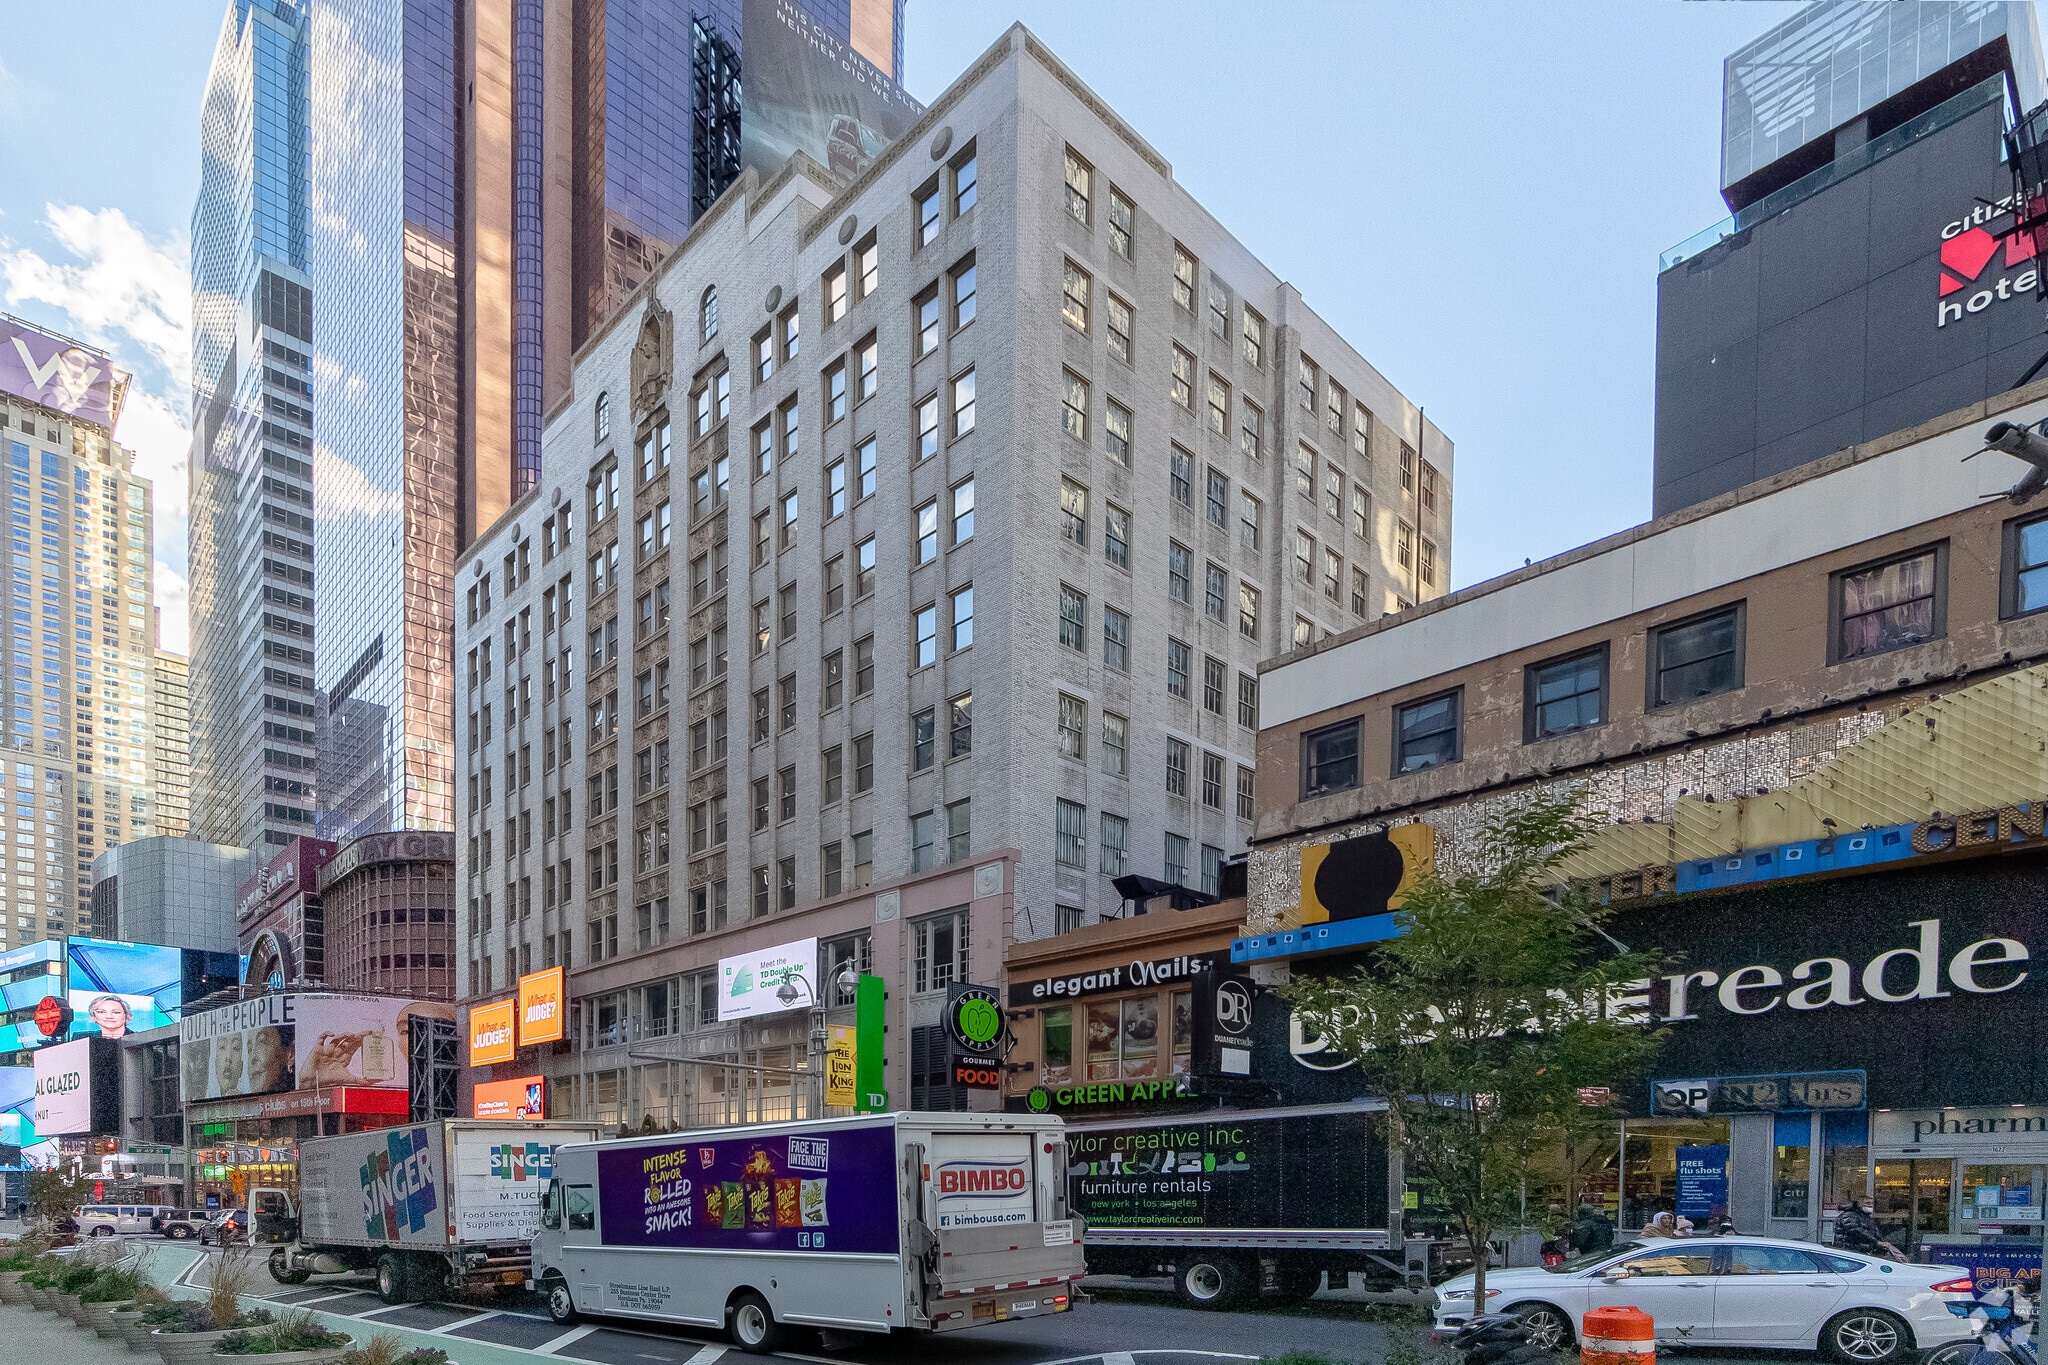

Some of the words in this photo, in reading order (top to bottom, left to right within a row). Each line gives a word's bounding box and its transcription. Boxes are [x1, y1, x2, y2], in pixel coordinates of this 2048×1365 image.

[776, 9, 836, 62] NEITHER
[842, 60, 865, 83] DID
[870, 81, 894, 106] WE.
[813, 25, 843, 52] CITY
[849, 52, 890, 91] NEVER
[10, 336, 102, 403] W
[760, 960, 776, 970] Meet
[776, 957, 788, 965] the
[760, 971, 769, 979] TD
[770, 964, 793, 977] Double
[794, 963, 805, 973] Up
[1659, 918, 2031, 1023] reade
[760, 979, 781, 989] Credit
[781, 976, 800, 985] Crd.
[1032, 967, 1121, 998] elegant
[1129, 956, 1202, 986] Nails
[528, 994, 547, 1006] What
[549, 992, 556, 1002] is
[959, 992, 1000, 1009] GREEN
[1217, 989, 1252, 1025] DR
[221, 1007, 229, 1019] TO
[233, 994, 296, 1033] PEOPLE
[525, 1001, 556, 1023] JUDGE?
[181, 1009, 217, 1043] YOUTH
[219, 1021, 231, 1034] THE
[478, 1022, 498, 1034] What
[500, 1020, 507, 1030] is
[473, 1028, 511, 1049] JUDGE?
[959, 1034, 998, 1050] APPLE
[834, 1049, 850, 1058] THE
[962, 1057, 996, 1066] GOURMET
[832, 1059, 852, 1073] LION
[46, 1071, 80, 1095] GLAZED
[829, 1074, 854, 1090] KING
[956, 1069, 1000, 1085] FOOD
[866, 1093, 885, 1107] TD
[1056, 1082, 1126, 1106] GREEN
[1912, 1110, 2048, 1143] pharm
[1114, 1127, 1200, 1151] creative
[1209, 1124, 1251, 1146] inc.
[791, 1140, 810, 1154] FACE
[811, 1142, 827, 1156] THE
[490, 1153, 552, 1168] SINGE
[643, 1149, 687, 1174] INTENSE
[790, 1153, 827, 1168] INTENSITY
[650, 1167, 682, 1185] FLAVOR
[1680, 1167, 1694, 1175] flu
[362, 1147, 434, 1222] SINGER
[939, 1168, 1026, 1194] BIMBO
[1080, 1178, 1148, 1195] furniture
[1152, 1176, 1212, 1193] rentals
[645, 1205, 656, 1215] INTO
[657, 1203, 666, 1212] AN
[666, 1197, 692, 1210] AWESOME
[749, 1186, 770, 1212] Takis
[1111, 1200, 1131, 1209] york
[1143, 1200, 1157, 1208] los
[1159, 1199, 1198, 1210] angeles
[488, 1210, 520, 1218] Service
[645, 1206, 692, 1235] SNACK!
[954, 1212, 1026, 1226] bimbousa.com
[1086, 1214, 1204, 1225] www.taylorcreativeinc.com
[466, 1220, 505, 1229] Supplies
[1976, 1266, 2012, 1279] BIG
[640, 1290, 657, 1298] Center
[658, 1292, 671, 1300] Drive
